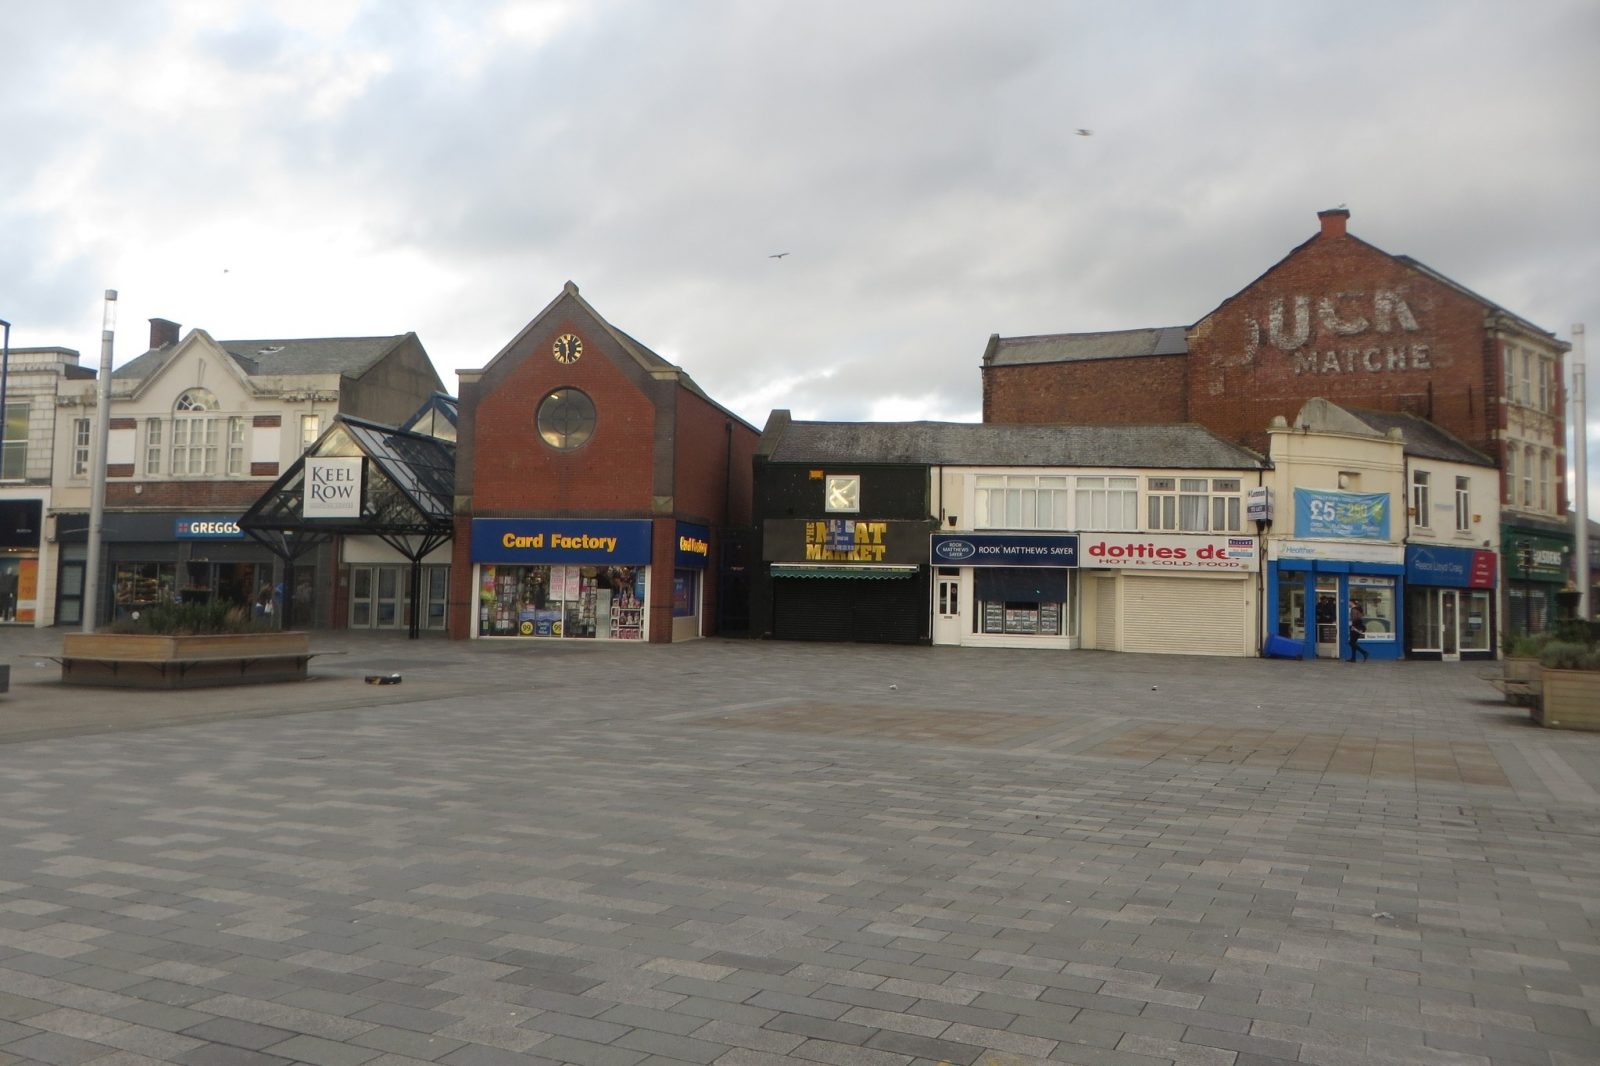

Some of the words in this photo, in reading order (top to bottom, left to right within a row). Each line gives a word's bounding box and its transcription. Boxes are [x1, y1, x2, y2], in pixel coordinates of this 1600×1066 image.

[311, 466, 354, 485] KEEL
[311, 484, 353, 503] ROW
[1310, 499, 1336, 521] £5
[190, 521, 241, 534] GREGGS
[805, 521, 815, 543] THE
[815, 521, 887, 544] MAT
[502, 533, 544, 548] Card
[551, 533, 618, 553] Factory
[978, 546, 1001, 554] ROOK
[1003, 547, 1048, 555] MATTHEWS
[1050, 547, 1074, 555] SAYER
[1088, 542, 1187, 559] dotties
